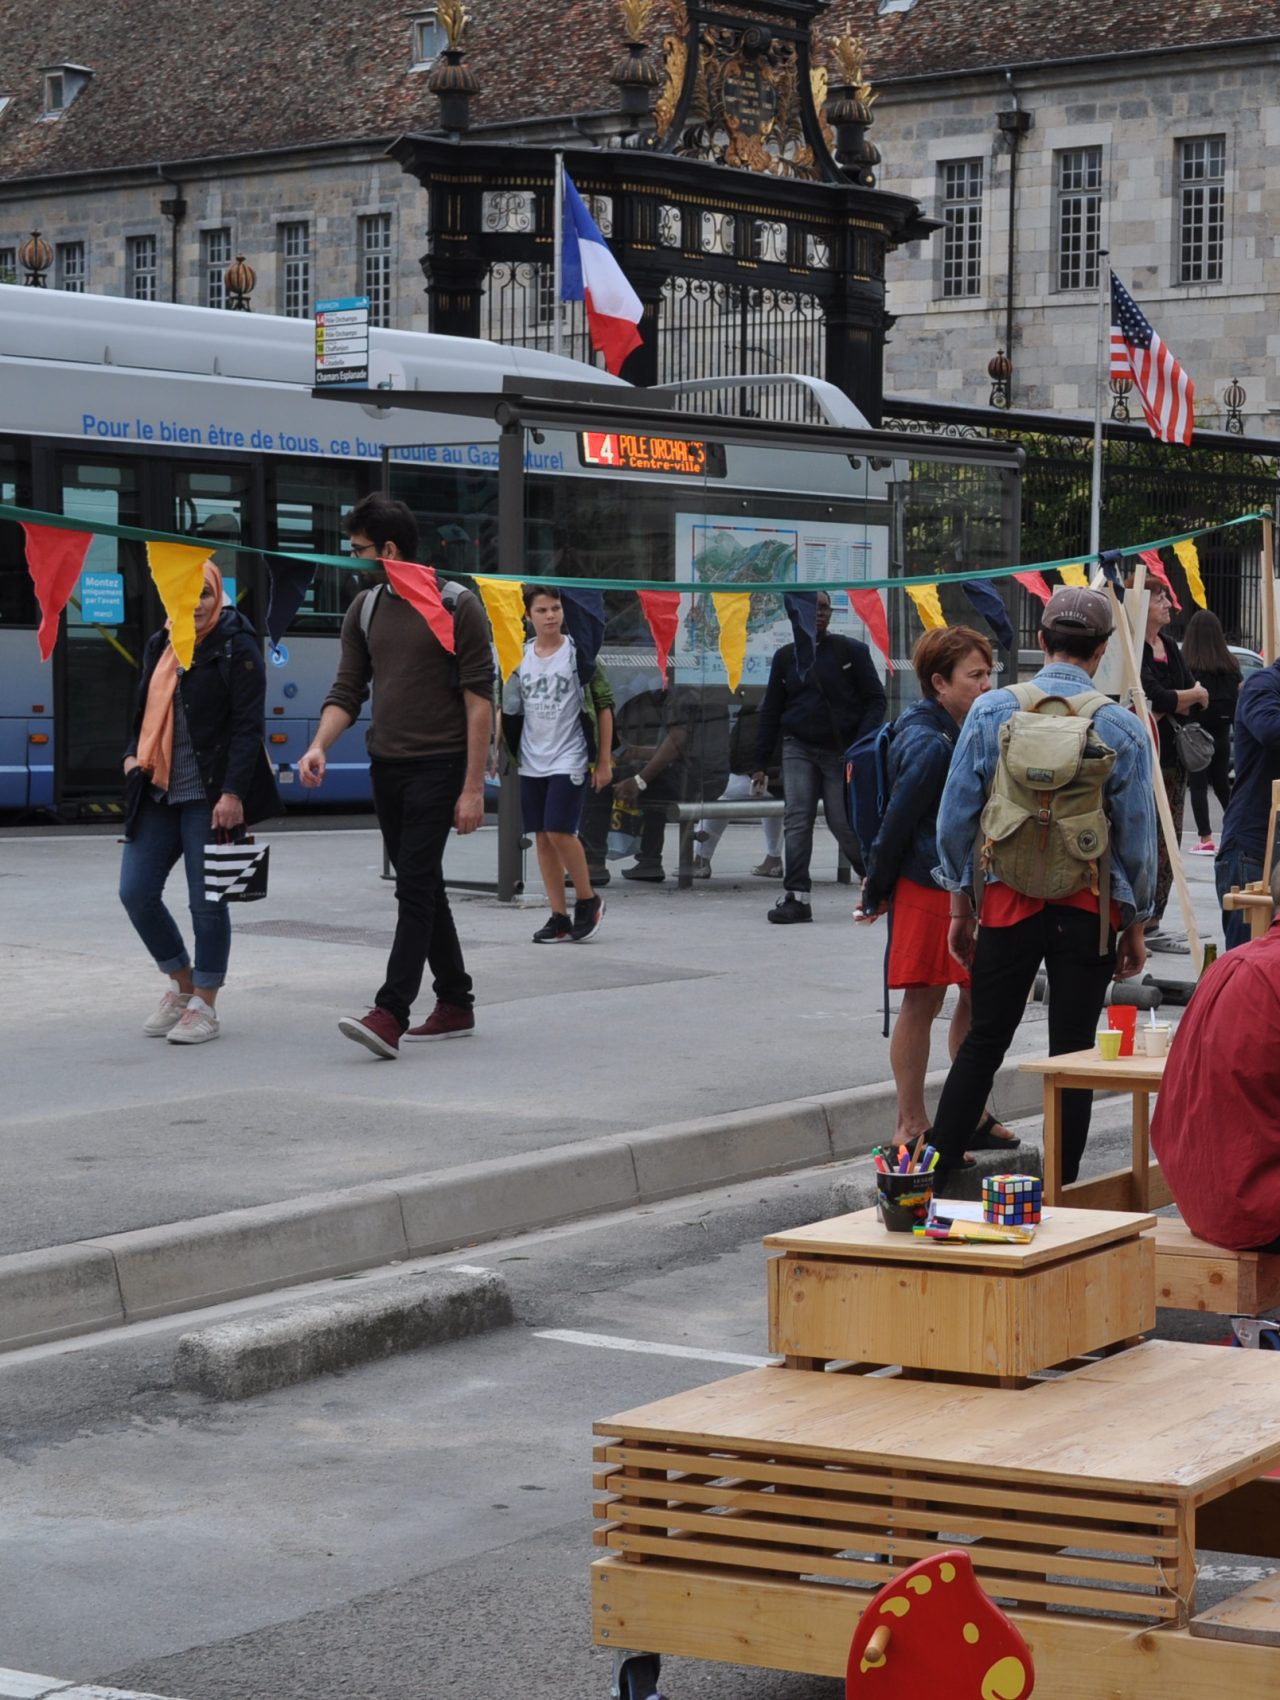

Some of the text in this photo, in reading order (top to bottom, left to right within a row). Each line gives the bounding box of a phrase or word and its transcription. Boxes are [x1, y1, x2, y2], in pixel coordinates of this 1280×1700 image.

[317, 369, 367, 382] Chamars Esplanade
[83, 415, 130, 438] Pour
[137, 419, 154, 440] le
[160, 421, 202, 444] bien
[208, 424, 245, 447] être
[251, 430, 274, 450] de
[279, 432, 325, 454] tous,
[330, 439, 350, 455] ce
[356, 437, 385, 457] bus
[393, 443, 437, 462] roule
[442, 448, 463, 464] au
[467, 445, 499, 467] Gaz
[583, 431, 615, 465] L4
[620, 435, 705, 463] POLE ORCHAS
[630, 457, 701, 472] Centre-ville
[86, 577, 118, 587] Montez
[522, 673, 569, 702] GAP
